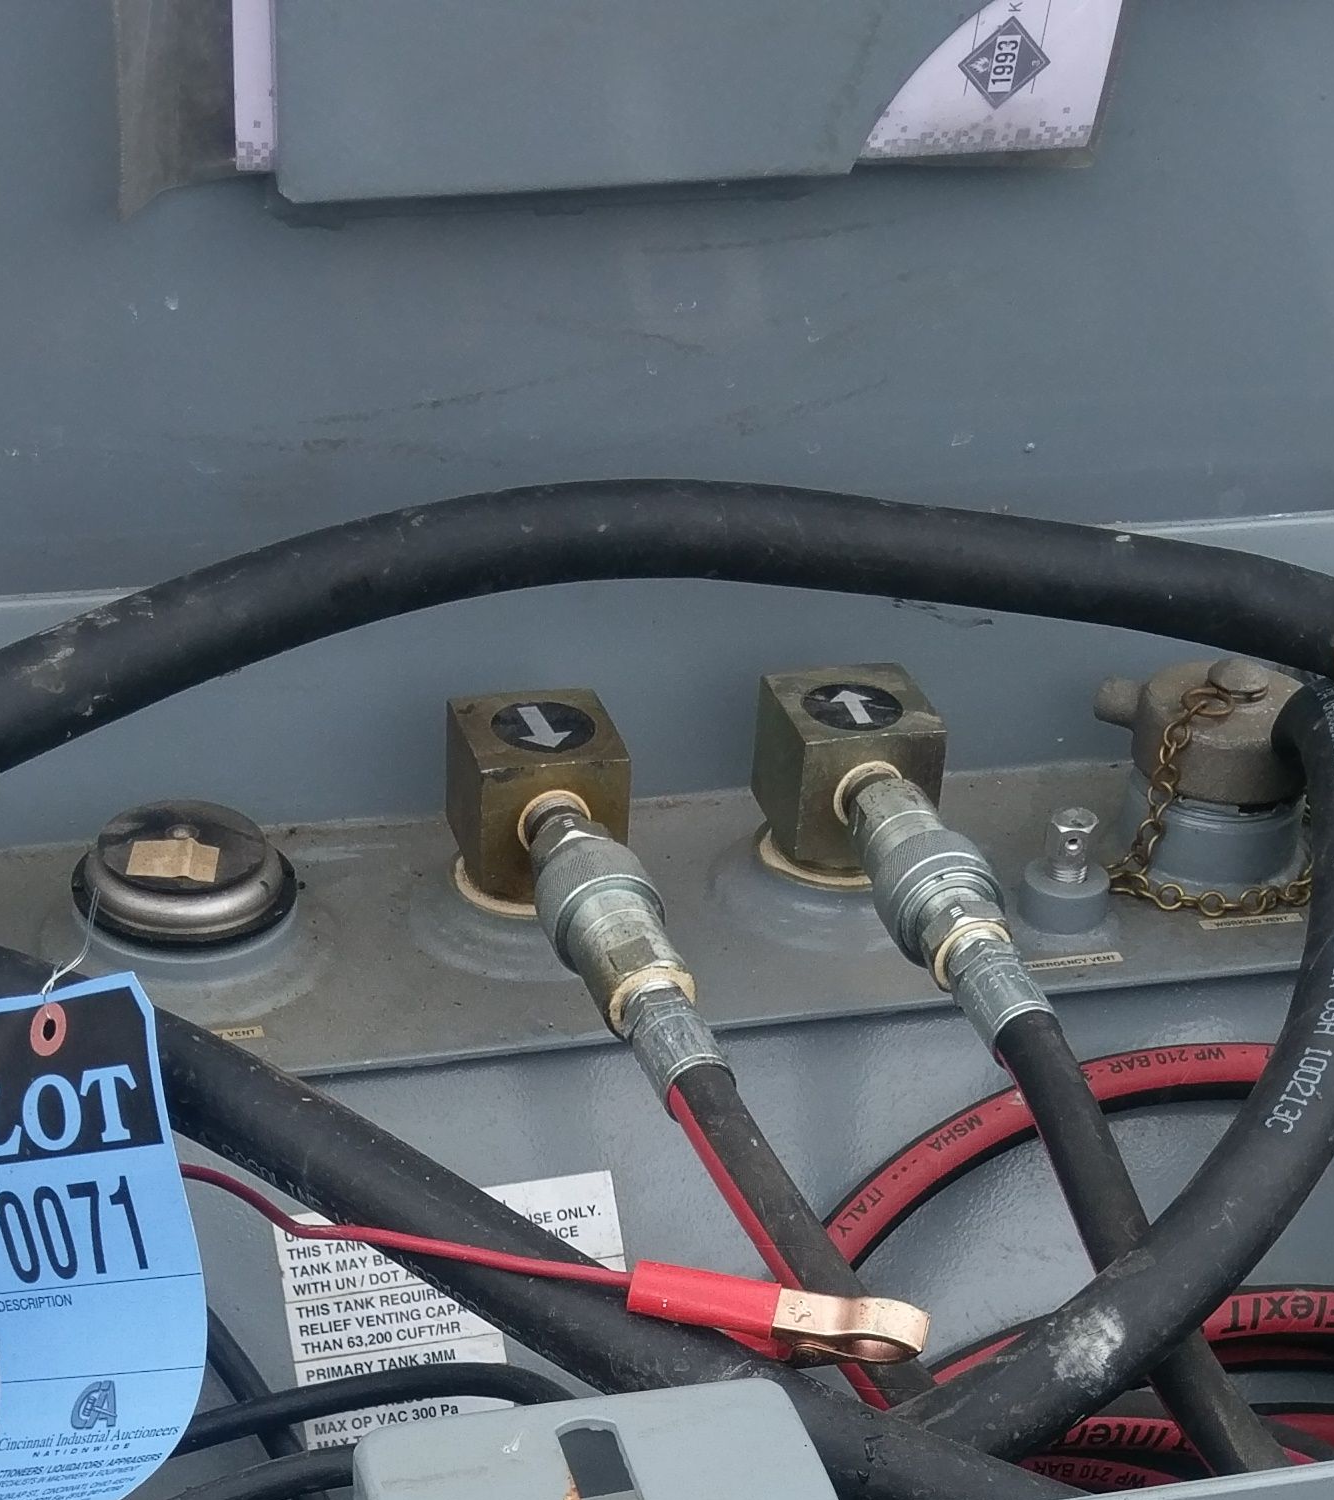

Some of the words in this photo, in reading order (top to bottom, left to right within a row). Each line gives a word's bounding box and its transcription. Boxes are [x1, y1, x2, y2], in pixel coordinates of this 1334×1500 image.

[991, 40, 1018, 85] 1993
[1110, 1055, 1151, 1074] BAR
[1156, 1050, 1188, 1065] 210
[1195, 1048, 1227, 1061] WP
[926, 1114, 984, 1152] MSHA
[556, 1204, 601, 1222] ONLY.
[837, 1187, 885, 1238] ITALY
[287, 1244, 322, 1260] THIS
[289, 1262, 332, 1278] TANK
[335, 1256, 368, 1272] MAY
[293, 1281, 332, 1297] WITH
[335, 1277, 357, 1290] UN
[360, 1274, 365, 1288] /
[368, 1270, 400, 1286] DOT
[295, 1303, 331, 1319] THIS
[333, 1297, 376, 1314] TANK
[299, 1318, 352, 1337] RELIEF
[355, 1309, 422, 1328] VENTING
[301, 1337, 344, 1355] THAN
[347, 1331, 393, 1349] 63,200
[396, 1320, 462, 1341] CUFT/HR
[305, 1360, 374, 1383] PRIMARY
[378, 1353, 420, 1371] TANK
[423, 1348, 457, 1365] 3MM
[314, 1419, 348, 1436] MAX
[351, 1415, 373, 1430] OP
[375, 1410, 409, 1426] VAC
[411, 1406, 438, 1421] 300
[440, 1403, 460, 1416] Pa
[56, 1431, 110, 1447] Industrial
[110, 1426, 181, 1442] Auctioneers
[1034, 1460, 1072, 1478] BAR
[1080, 1464, 1113, 1483] 210
[1114, 1471, 1146, 1488] WP
